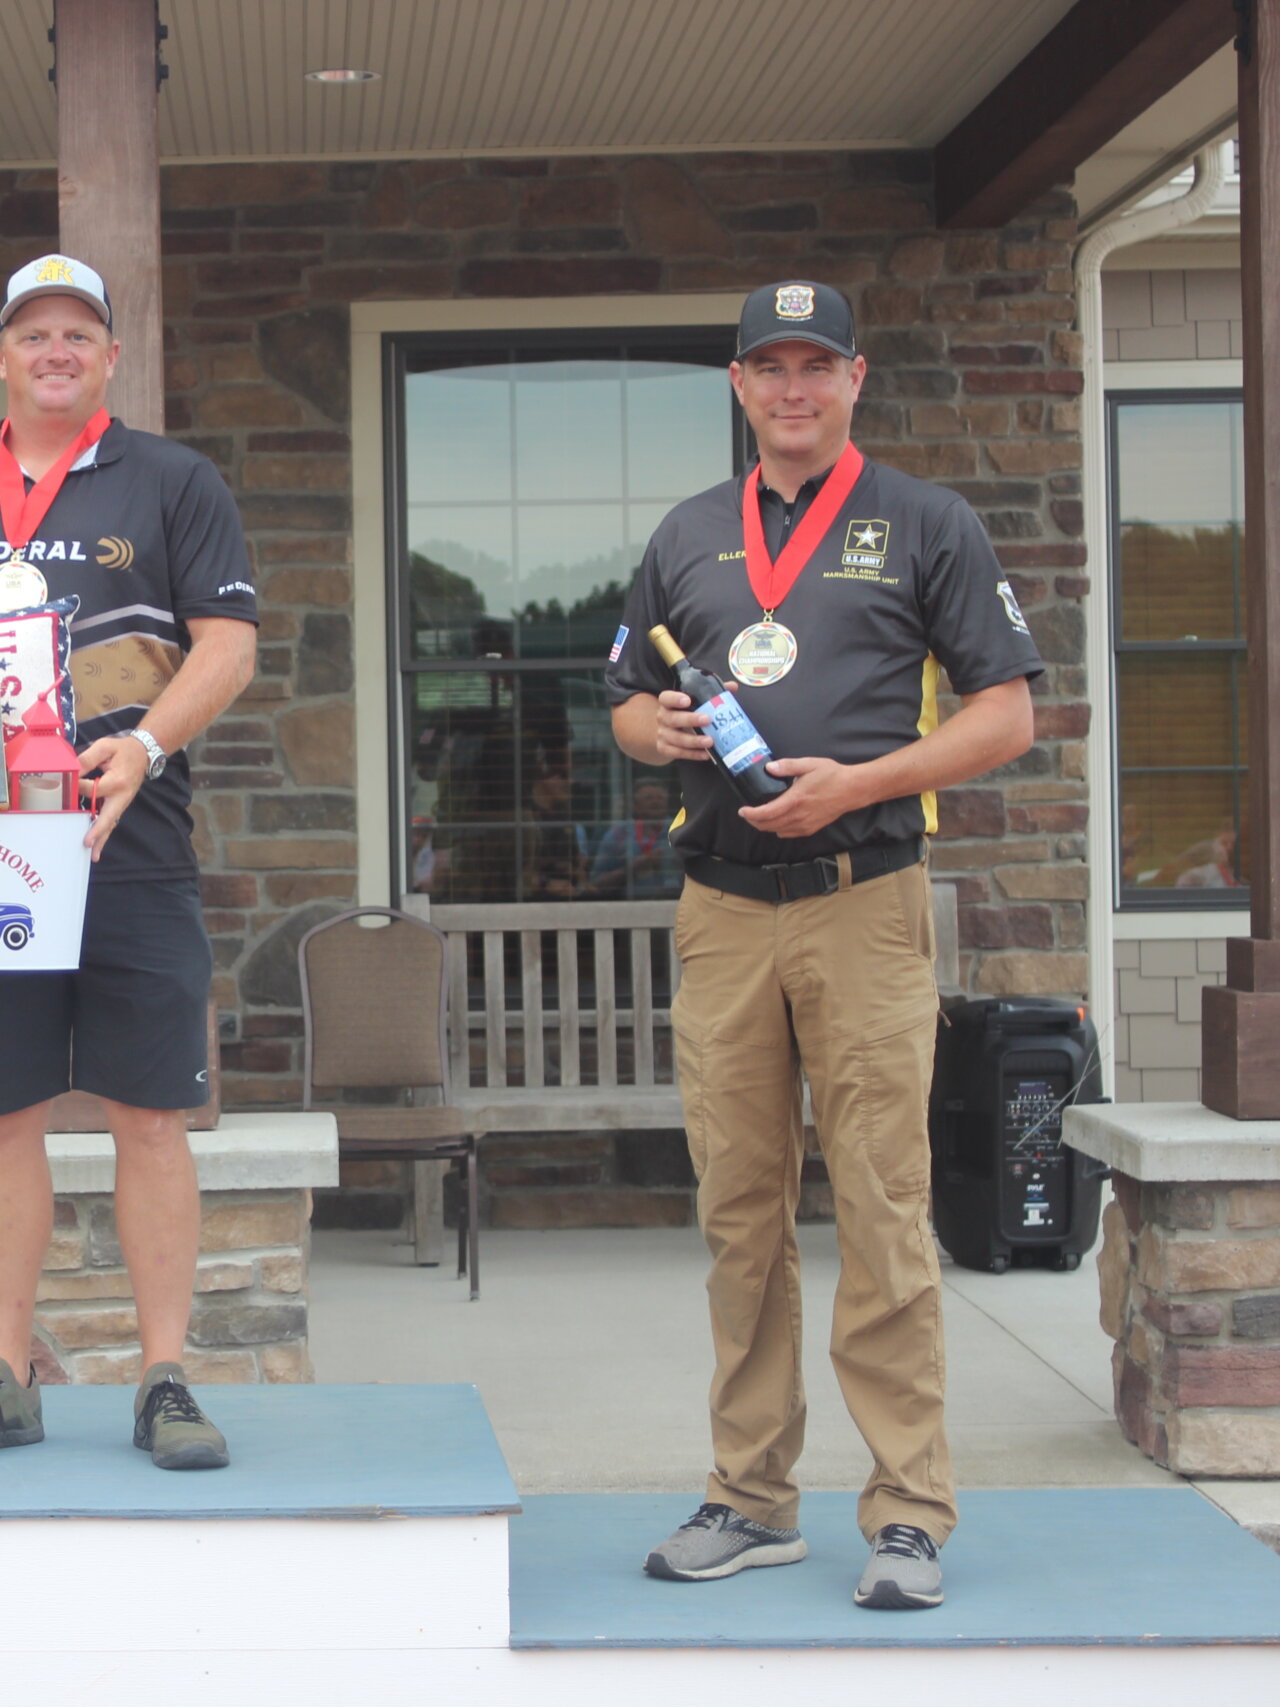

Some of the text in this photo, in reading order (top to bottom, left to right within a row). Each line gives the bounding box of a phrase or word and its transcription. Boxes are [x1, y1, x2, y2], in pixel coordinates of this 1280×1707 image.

[858, 568, 880, 576] ARMY
[823, 571, 900, 585] MARKSMANSHIP UNIT
